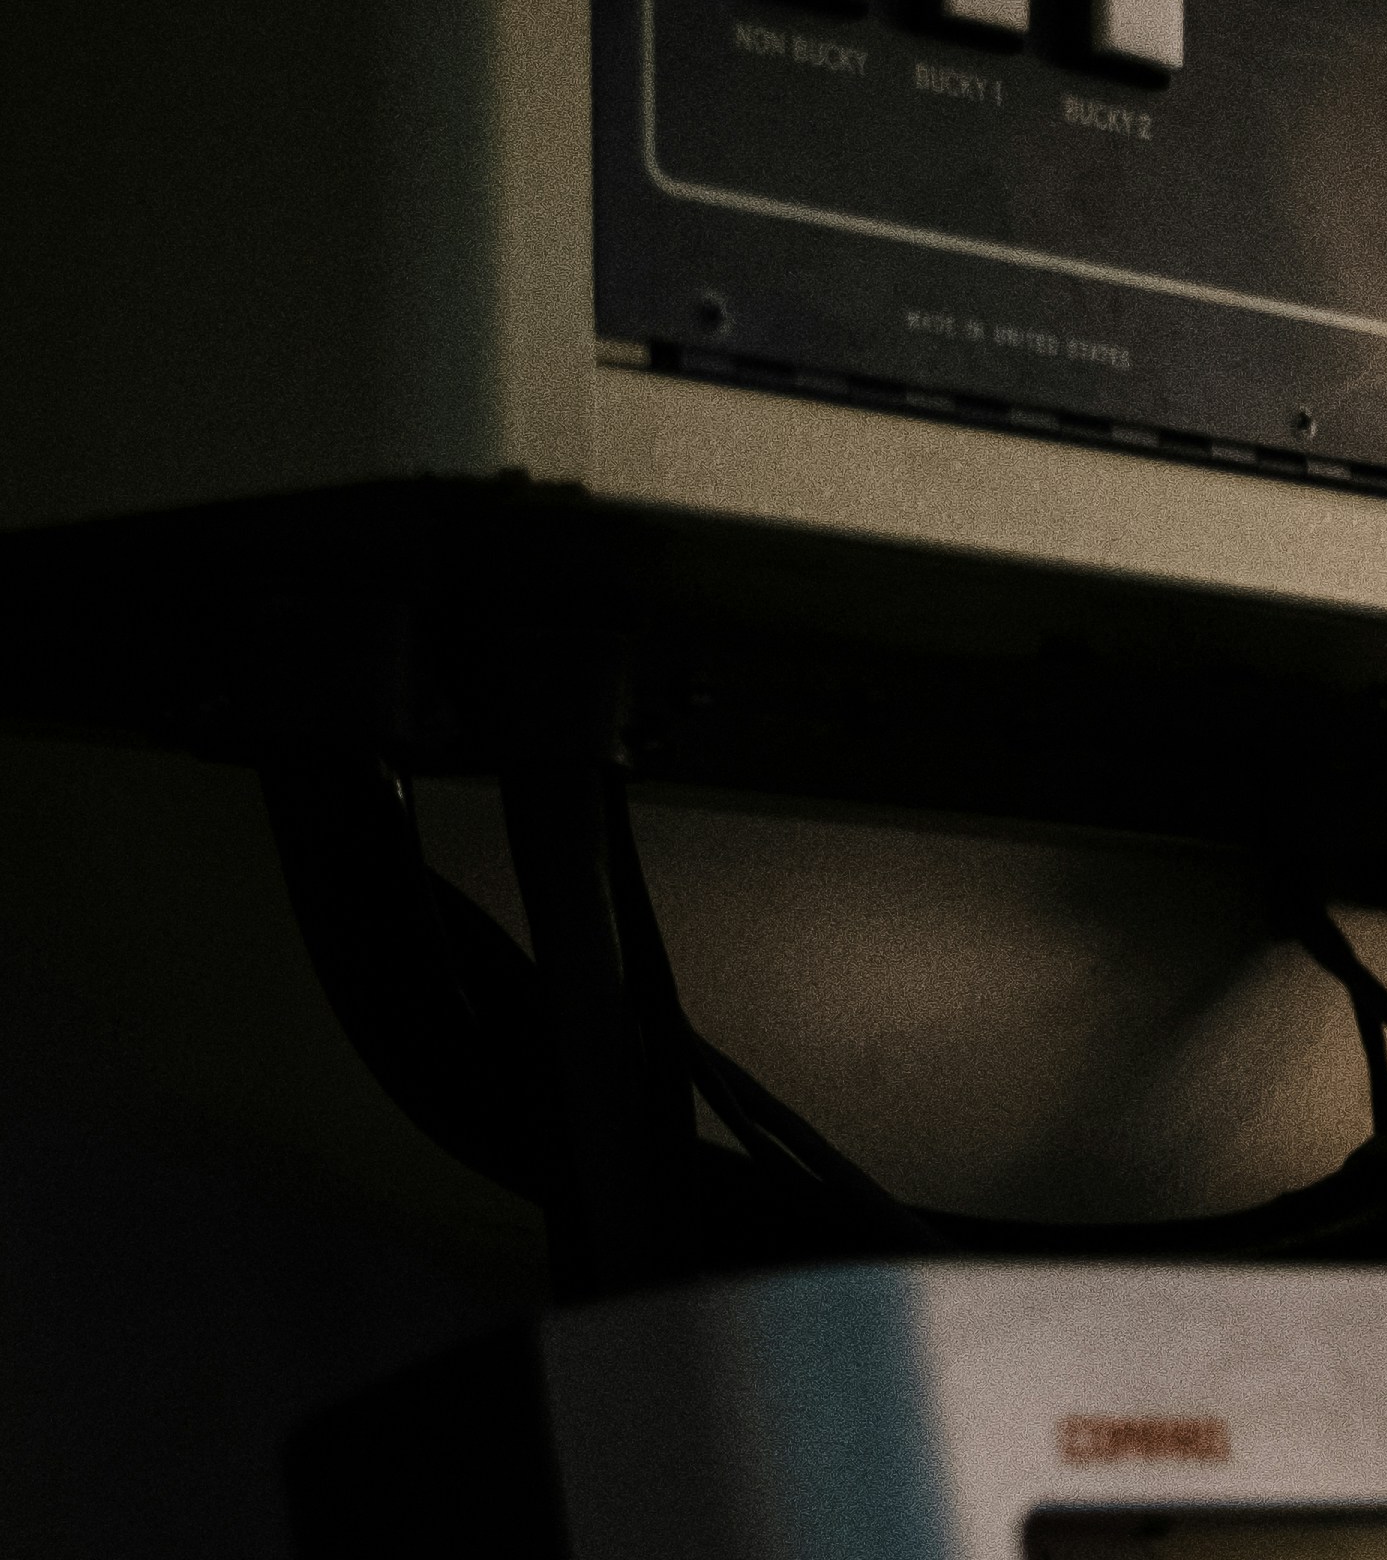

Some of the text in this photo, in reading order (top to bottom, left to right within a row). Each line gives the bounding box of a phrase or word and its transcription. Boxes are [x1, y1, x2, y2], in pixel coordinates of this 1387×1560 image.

[735, 22, 869, 78] NON BUCKY
[914, 61, 990, 103] BUCKY
[1062, 94, 1153, 141] BUCKY 2
